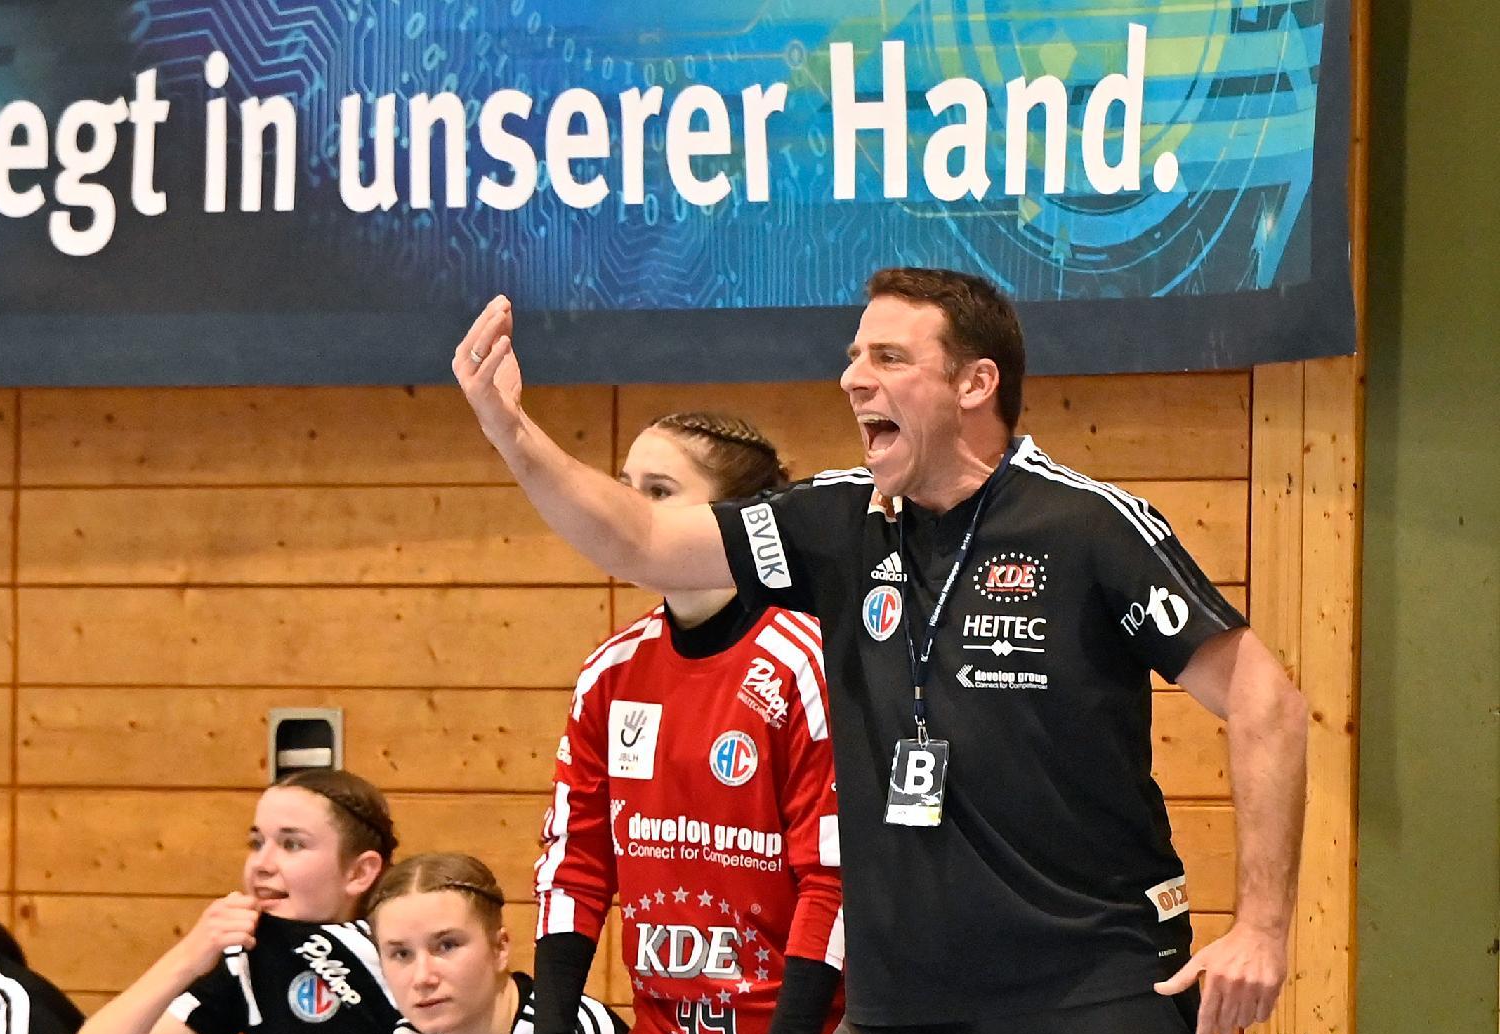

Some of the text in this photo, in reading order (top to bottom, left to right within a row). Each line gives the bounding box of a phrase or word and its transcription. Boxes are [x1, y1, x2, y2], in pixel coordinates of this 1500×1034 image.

[204, 49, 298, 213] in
[339, 82, 790, 214] unserer
[828, 21, 1180, 203] Hand.
[746, 507, 786, 580] BVUK
[986, 563, 1037, 590] KDE
[962, 614, 1047, 641] HEITEC
[974, 669, 1048, 685] develop group
[716, 737, 752, 779] HC
[903, 750, 936, 795] B
[628, 811, 783, 858] develop group
[627, 841, 782, 873] Connect for Competence!
[634, 922, 742, 980] KDE
